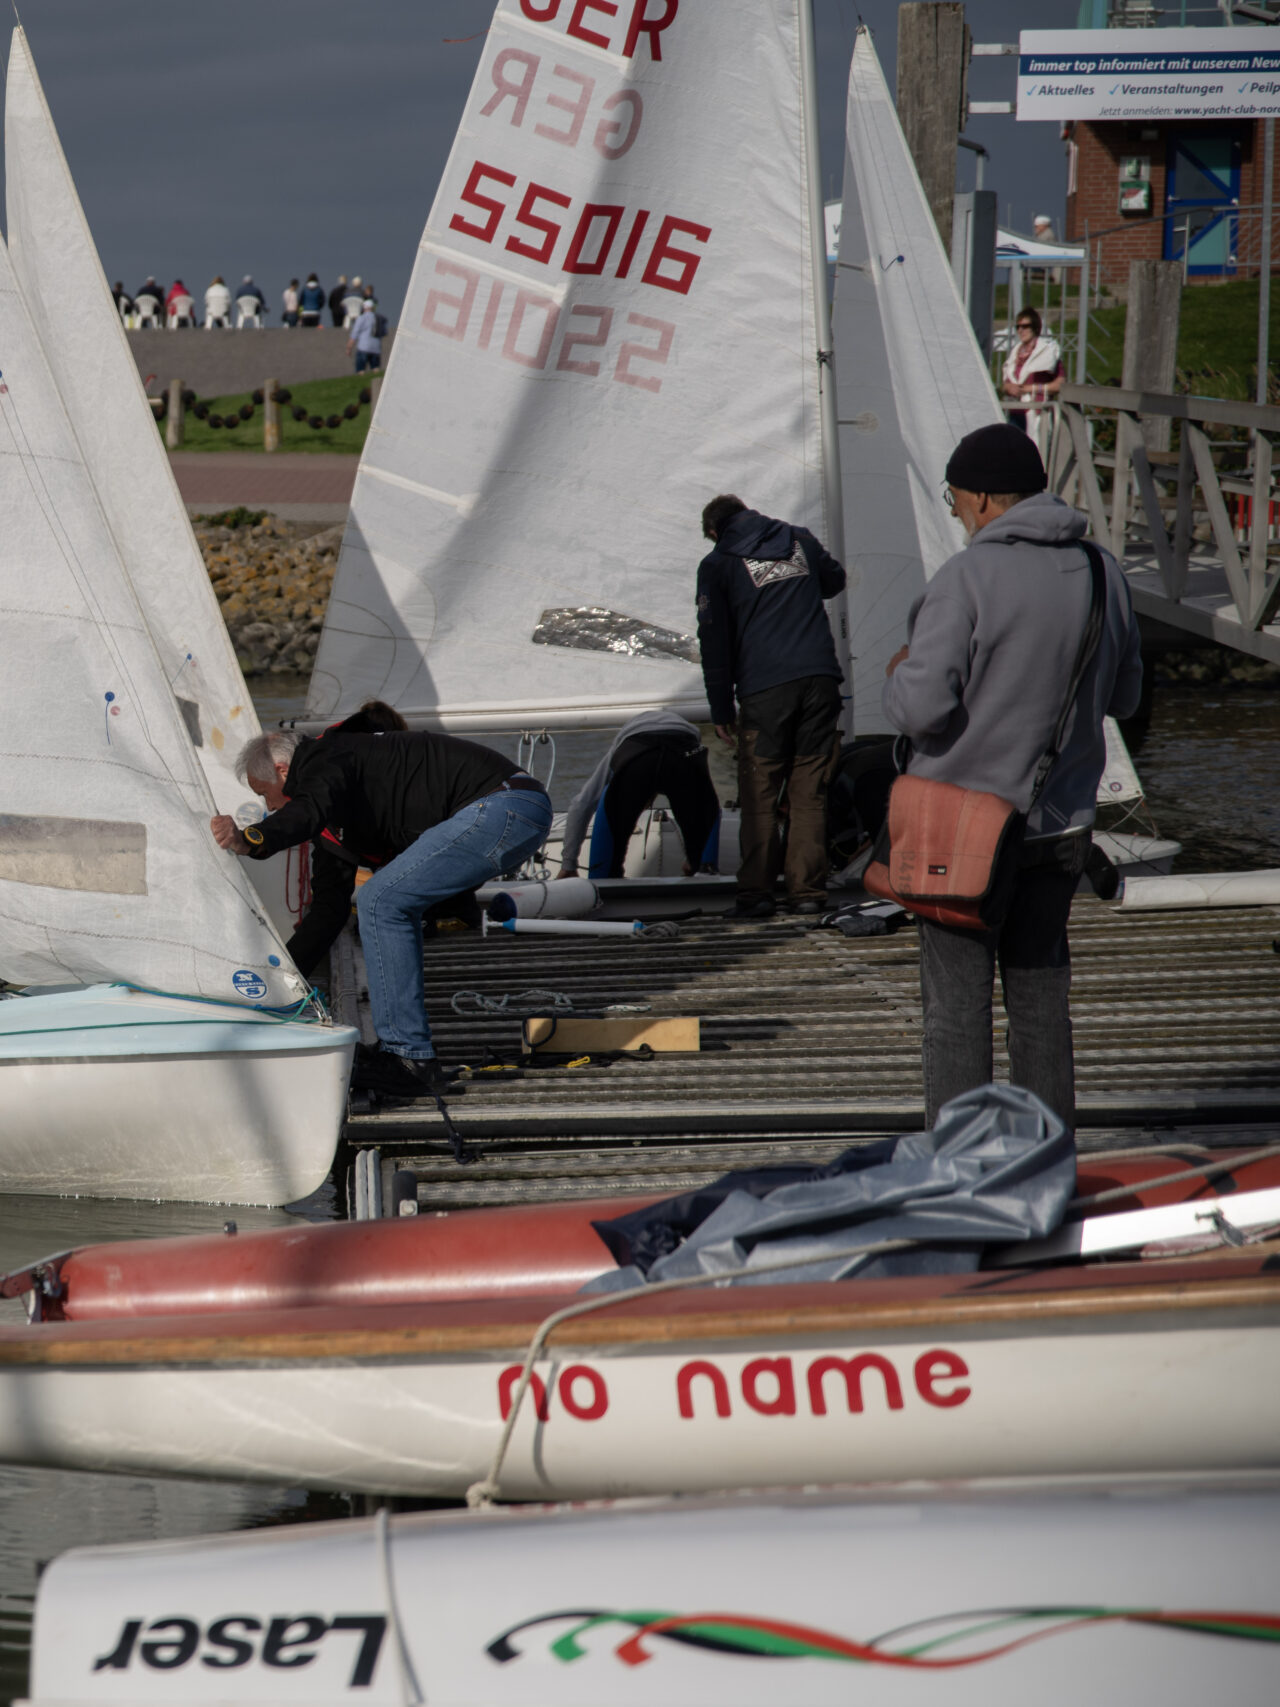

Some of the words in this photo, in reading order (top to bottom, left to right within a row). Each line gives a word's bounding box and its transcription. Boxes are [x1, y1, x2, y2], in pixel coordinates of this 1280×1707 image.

[1028, 59, 1072, 72] immer
[1073, 60, 1096, 74] top
[1098, 58, 1166, 71] informiert
[1167, 57, 1191, 70] mit
[1192, 58, 1249, 70] unserem
[1038, 84, 1095, 96] Aktuelles
[1122, 82, 1224, 97] Veranstaltungen
[1099, 106, 1121, 117] Jetzt
[1122, 105, 1173, 116] anmelden:
[448, 160, 713, 296] 55016
[497, 1363, 609, 1423] no
[676, 1348, 972, 1419] name
[92, 1613, 389, 1688] Laser
